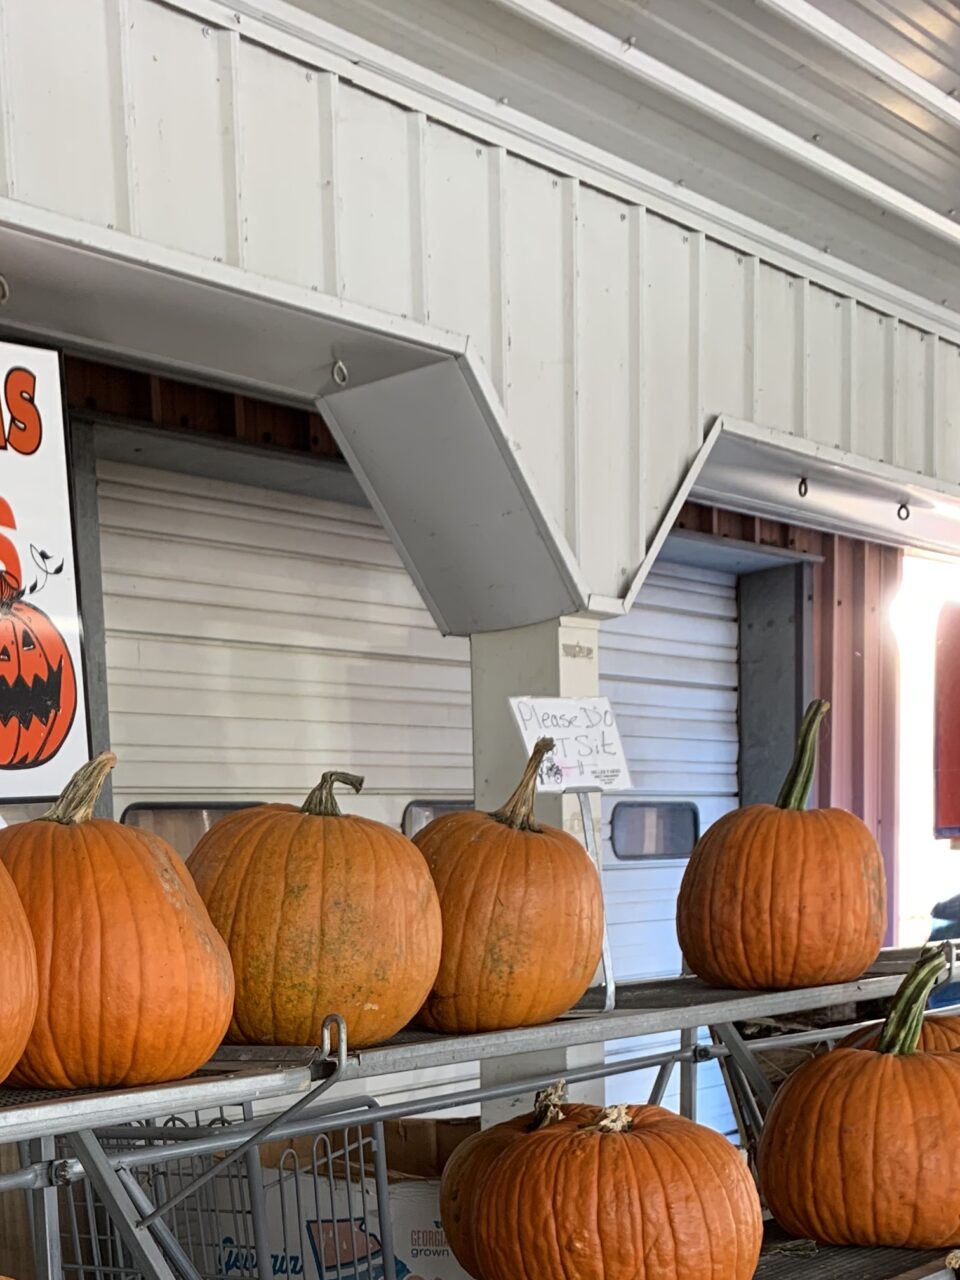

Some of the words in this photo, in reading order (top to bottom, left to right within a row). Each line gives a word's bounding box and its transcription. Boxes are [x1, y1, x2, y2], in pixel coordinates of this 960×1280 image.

[517, 701, 581, 731] Please
[574, 731, 617, 758] Sit
[410, 1248, 450, 1259] grown
